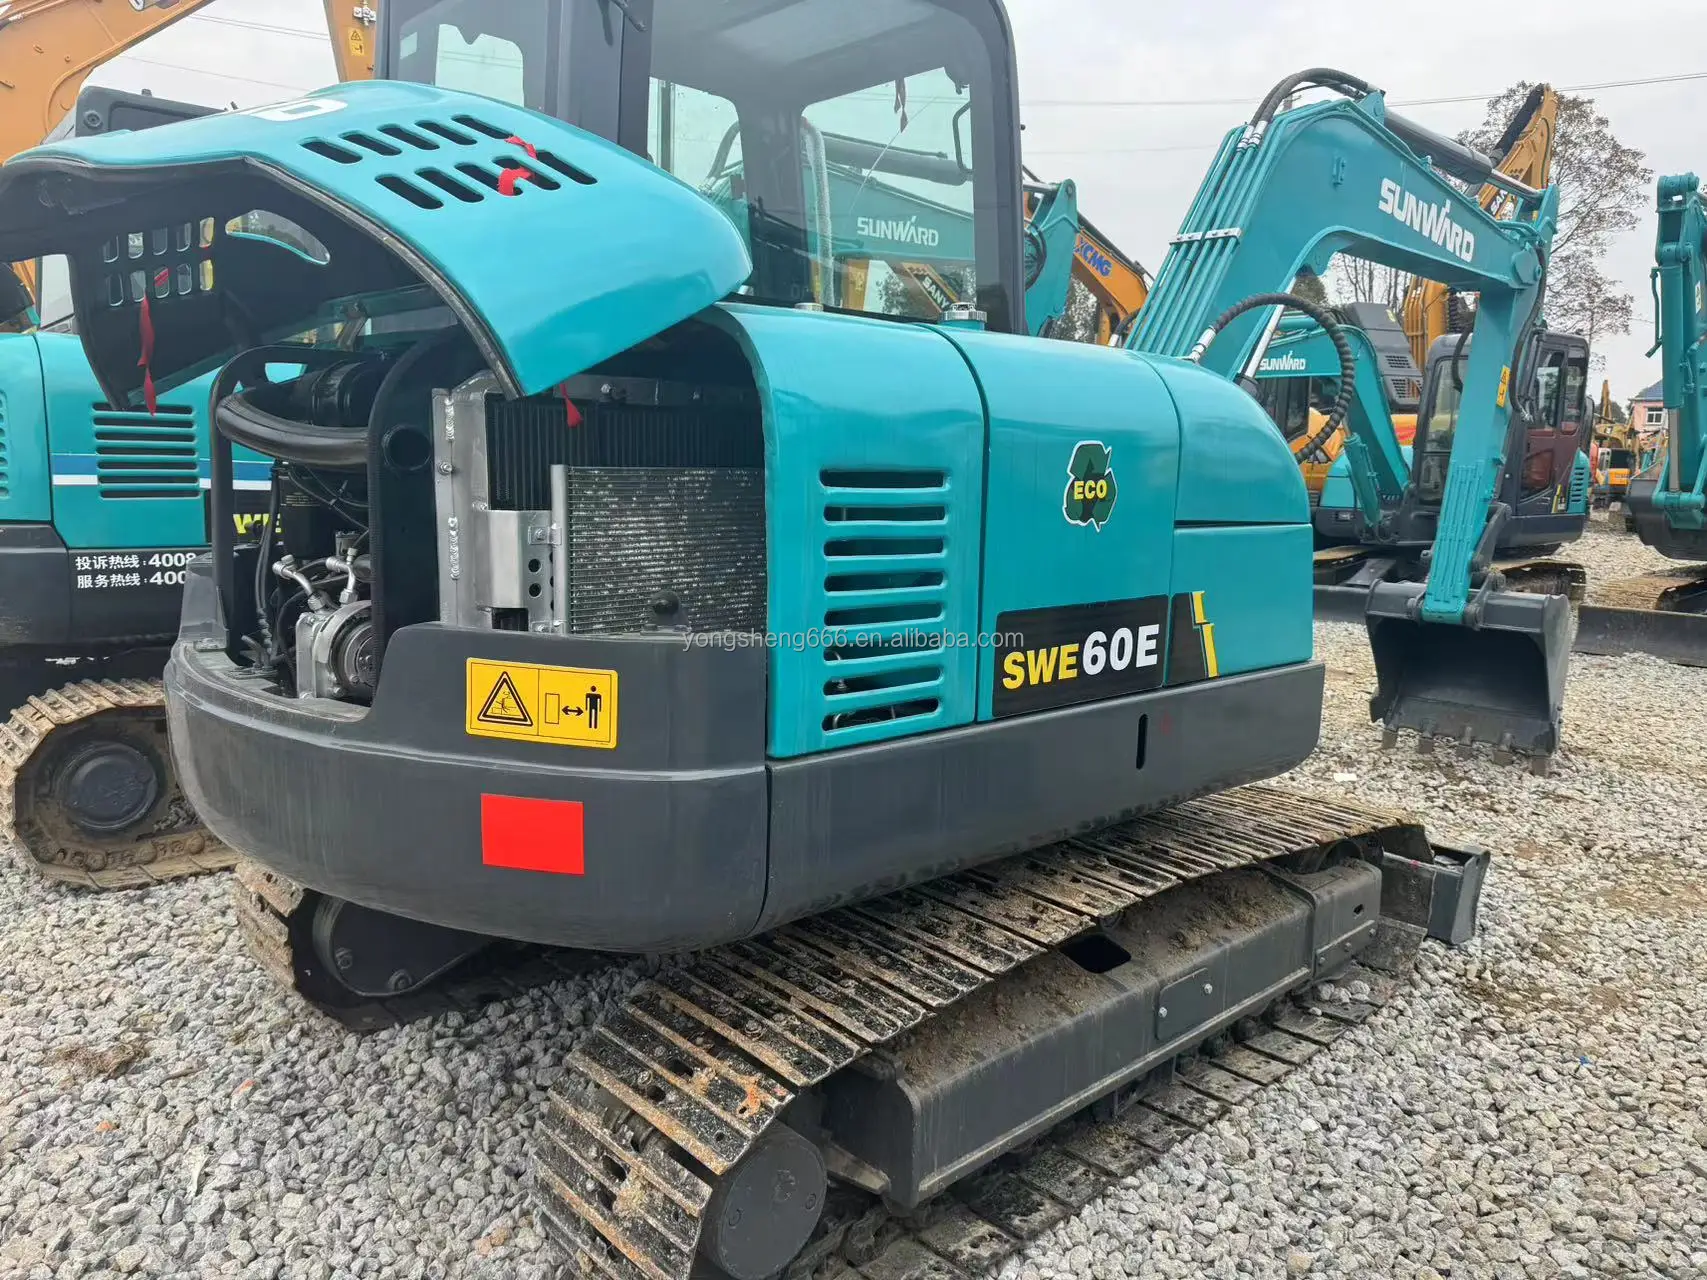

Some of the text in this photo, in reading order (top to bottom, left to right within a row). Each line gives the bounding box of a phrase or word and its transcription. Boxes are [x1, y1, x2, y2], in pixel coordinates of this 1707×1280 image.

[857, 215, 939, 247] SUNWARD
[1378, 177, 1475, 263] SUNWARD
[921, 276, 951, 309] SANY
[1259, 350, 1306, 371] SUNWARD
[1073, 479, 1108, 500] ECO
